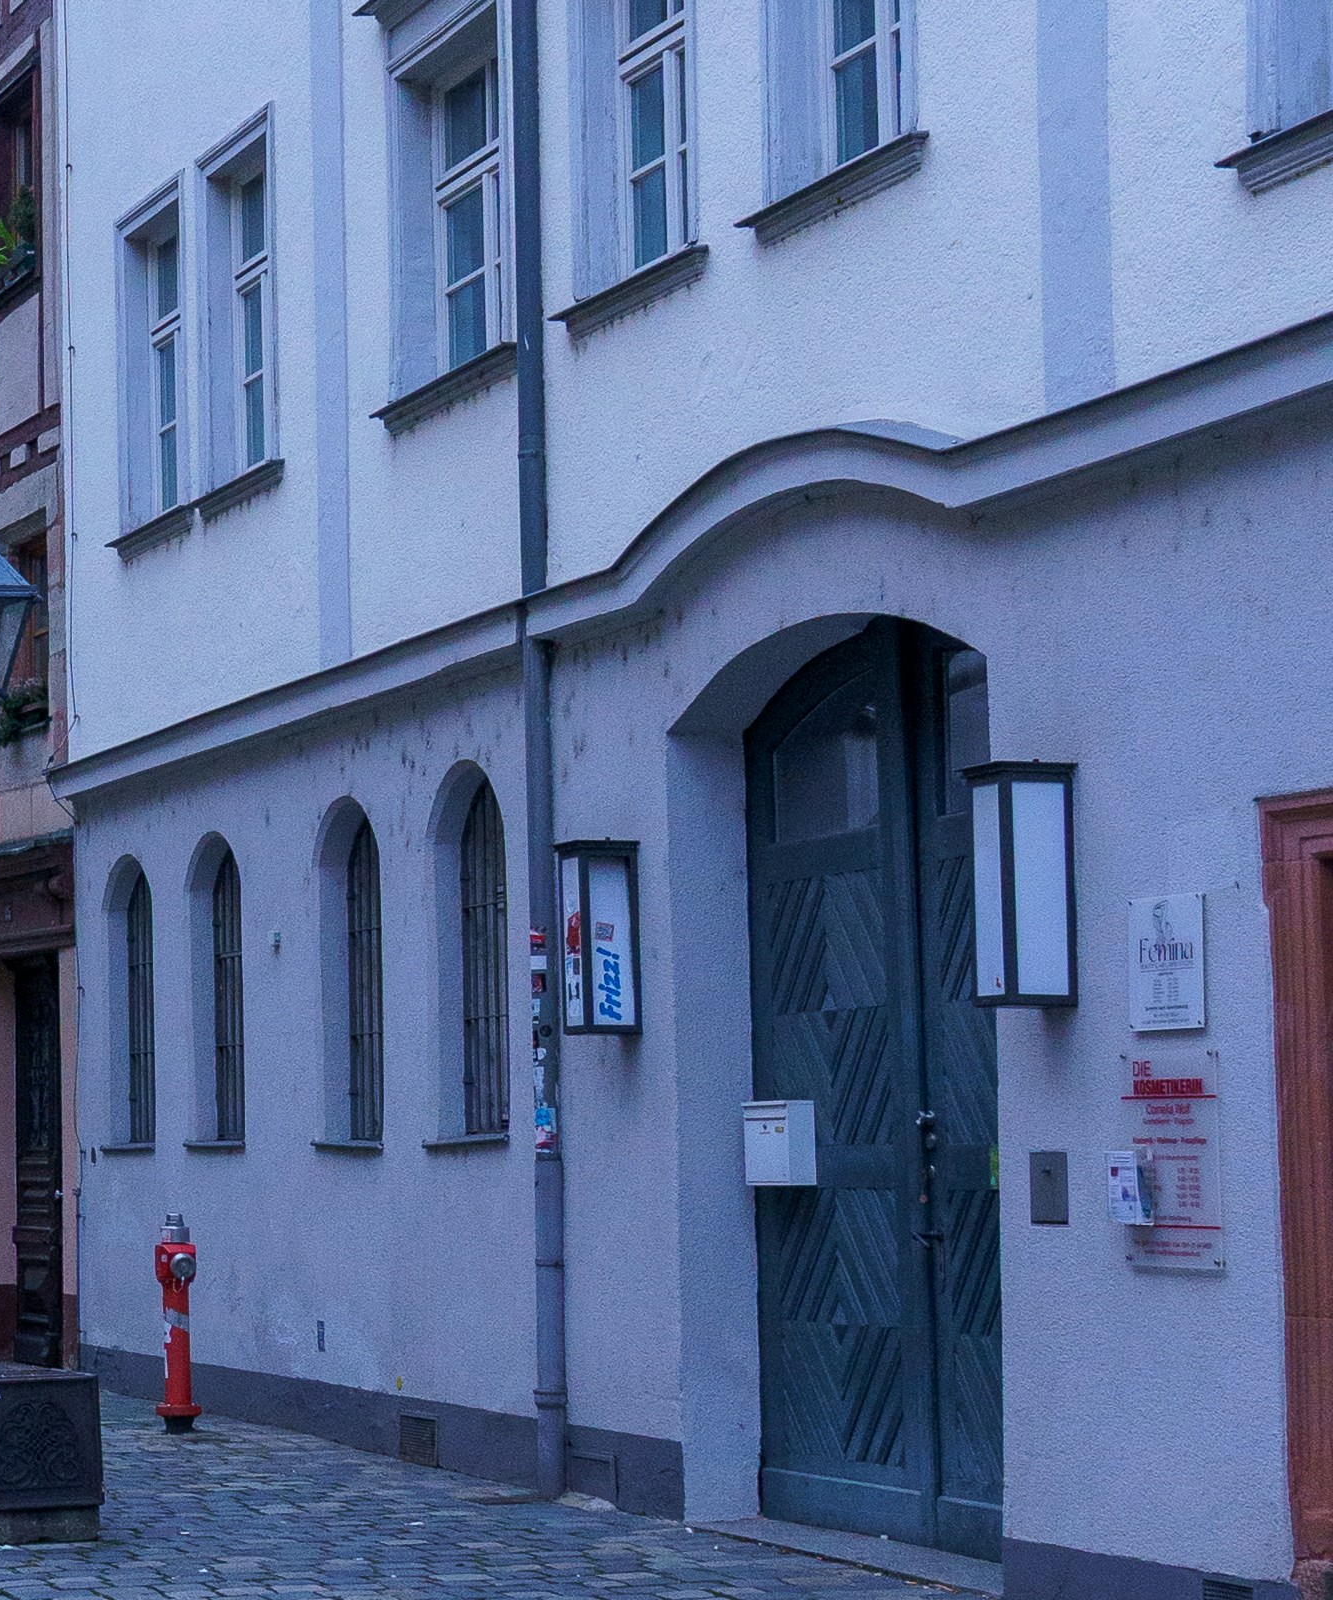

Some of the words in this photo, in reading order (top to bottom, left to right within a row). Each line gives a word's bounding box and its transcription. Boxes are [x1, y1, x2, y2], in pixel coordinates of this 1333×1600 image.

[1139, 937, 1193, 963] Femina
[595, 946, 622, 1021] Frizz!
[1133, 1060, 1152, 1077] DIE
[1133, 1078, 1203, 1095] KOSMETIKERIN
